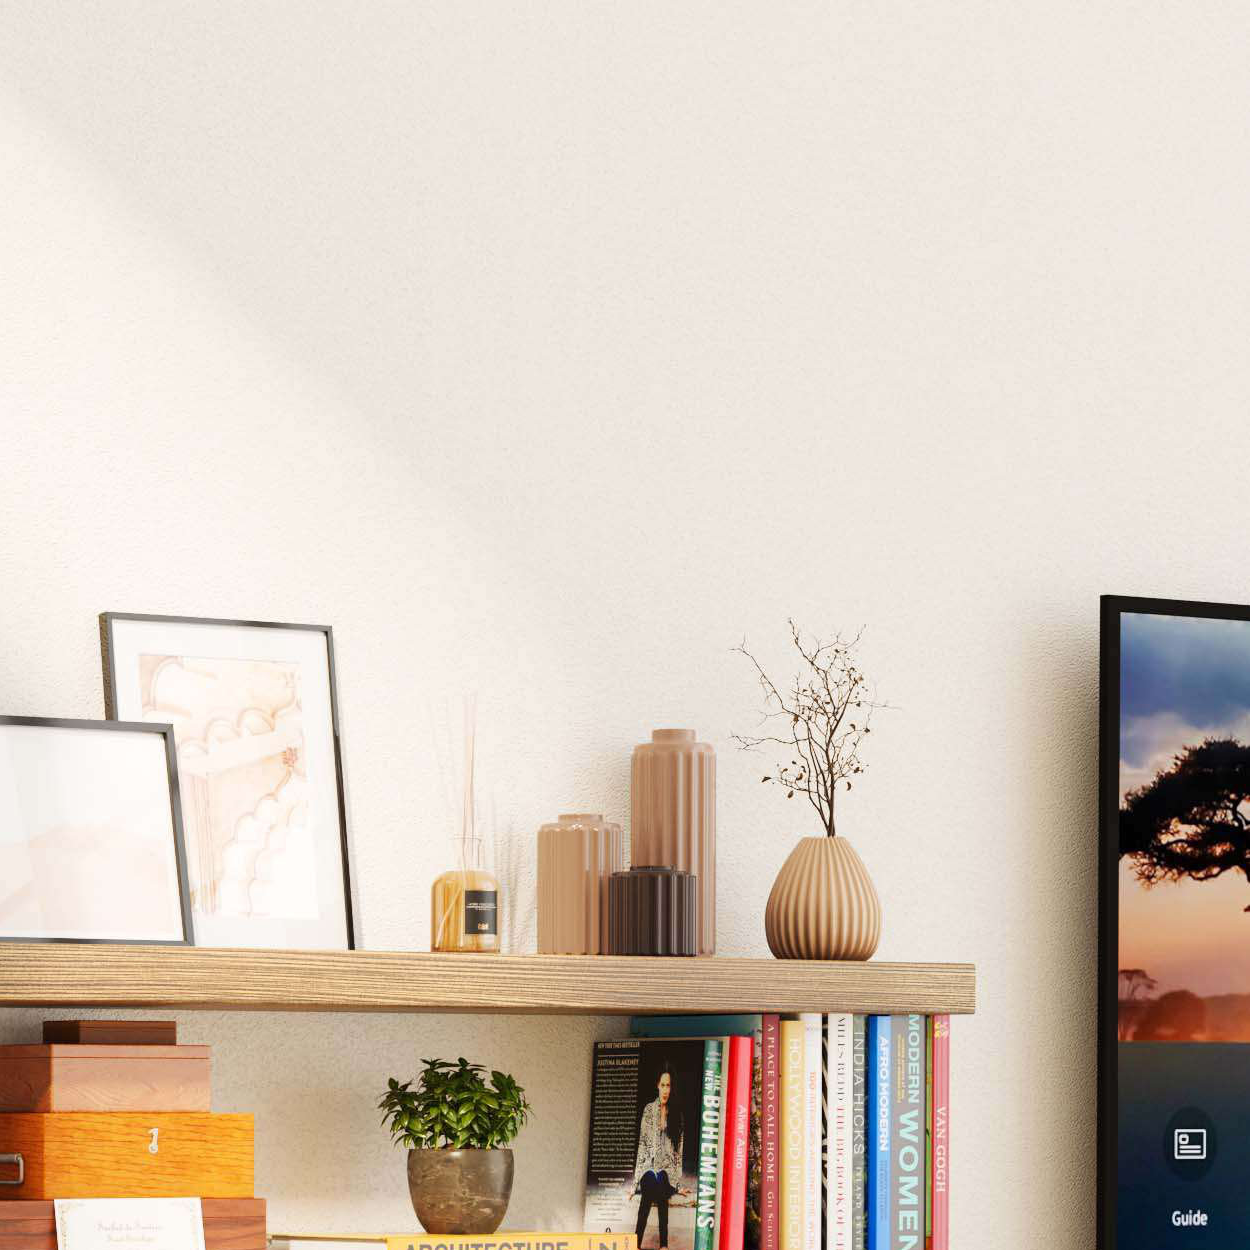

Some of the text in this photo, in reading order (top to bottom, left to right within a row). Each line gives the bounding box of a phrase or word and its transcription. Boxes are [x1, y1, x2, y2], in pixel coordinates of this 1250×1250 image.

[704, 1070, 714, 1090] NEW
[766, 1036, 775, 1079] PLACE
[879, 1036, 889, 1079] AFRO
[907, 1015, 919, 1103] MODERN
[766, 1083, 775, 1100] TO
[788, 1038, 802, 1160] HOLLYWOOD
[853, 1032, 864, 1154] INDIA HICKS
[878, 1083, 888, 1151] MODERN
[735, 1105, 747, 1169] Alvar Aalto
[766, 1104, 775, 1139] CALL
[697, 1095, 721, 1229] BOHEMIANS
[766, 1143, 775, 1182] HOME
[936, 1106, 946, 1193] VAN GOGH
[1172, 1210, 1208, 1226] Guide
